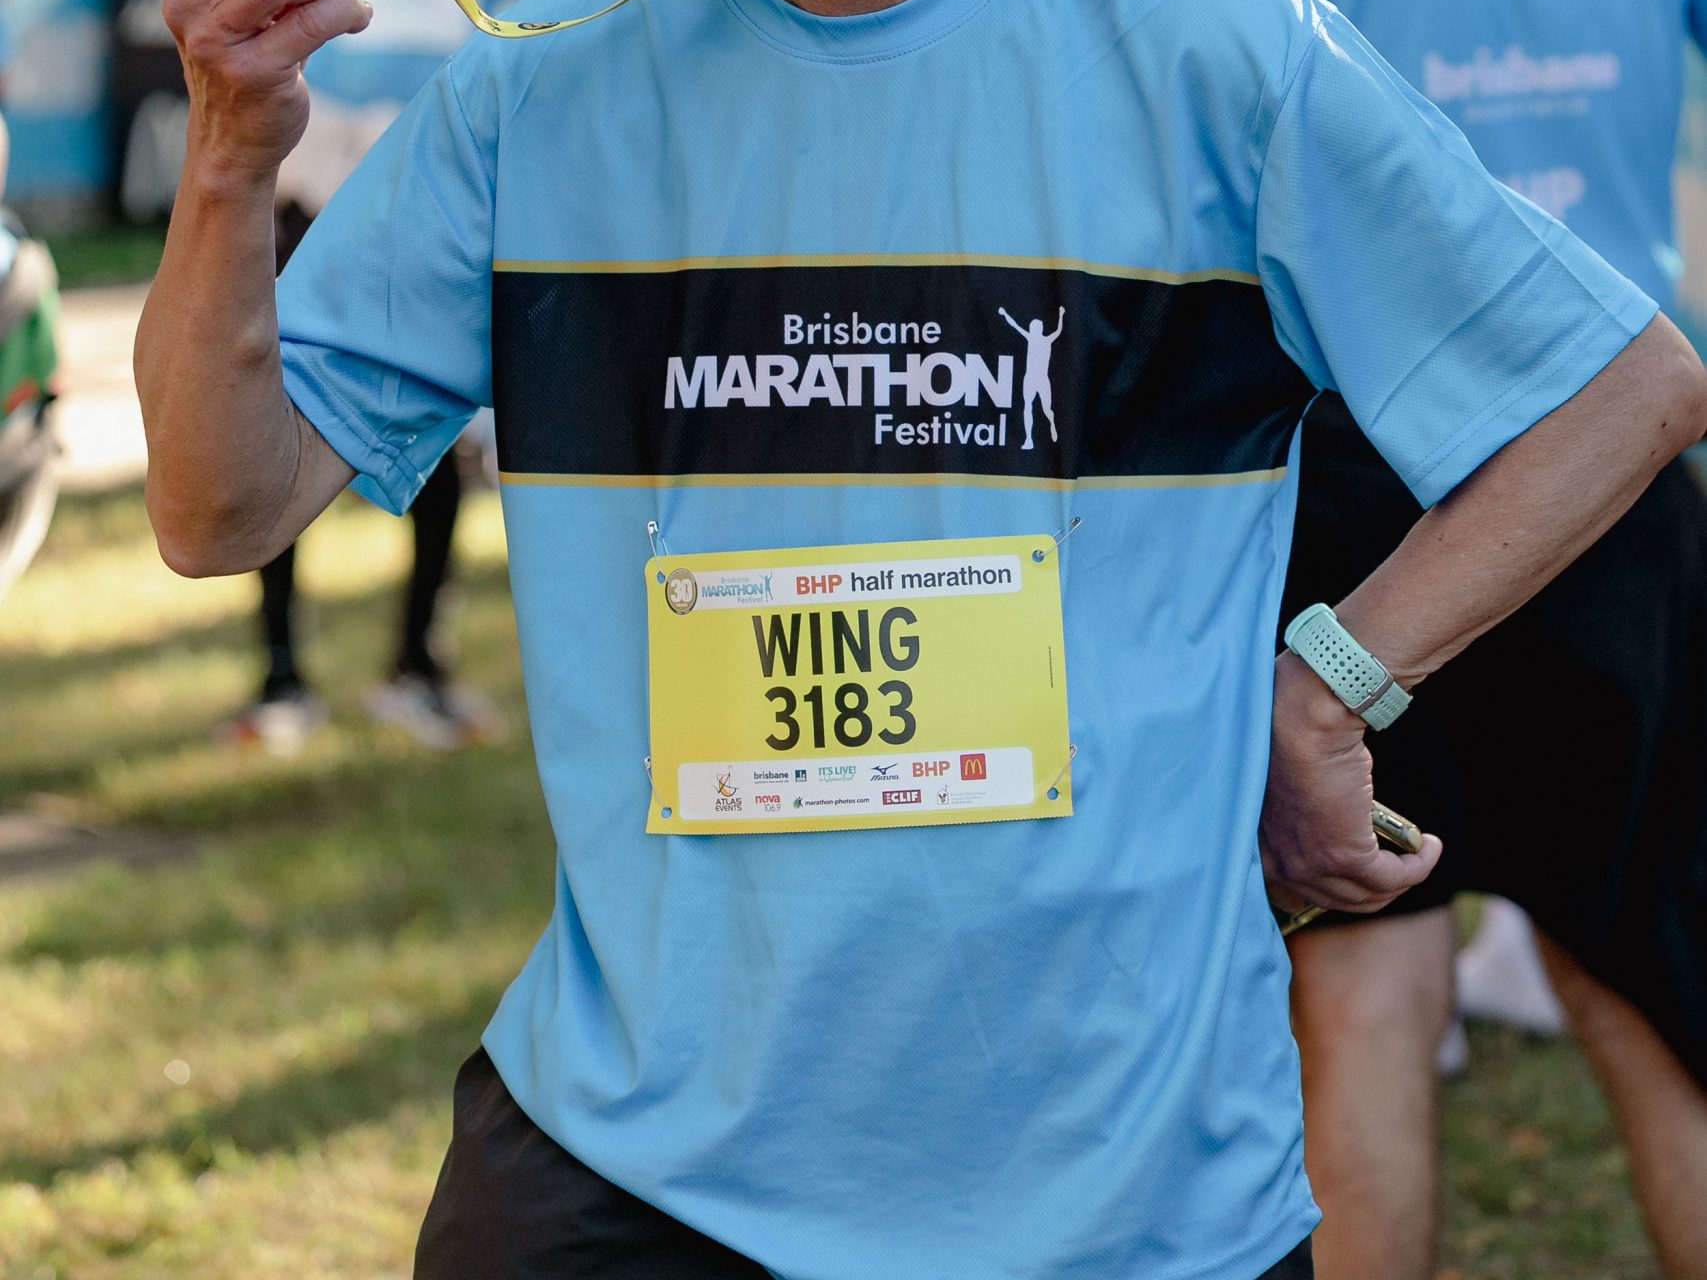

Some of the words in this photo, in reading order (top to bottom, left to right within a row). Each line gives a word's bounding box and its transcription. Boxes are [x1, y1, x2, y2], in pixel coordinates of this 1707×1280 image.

[783, 312, 941, 345] Brisbane
[664, 353, 1014, 409] MARATHON
[874, 412, 1006, 447] Festival
[721, 576, 749, 584] Brisbane
[796, 575, 842, 595] BHP
[851, 570, 894, 592] half
[901, 566, 1012, 589] marathon
[671, 579, 692, 602] 30
[701, 583, 763, 598] MARATHON
[737, 596, 763, 604] Festival
[752, 606, 919, 678] WING
[765, 680, 917, 751] 3183
[753, 771, 788, 780] brisbane
[835, 766, 856, 775] LIVE!
[912, 761, 950, 778] BHP
[755, 795, 780, 804] nova
